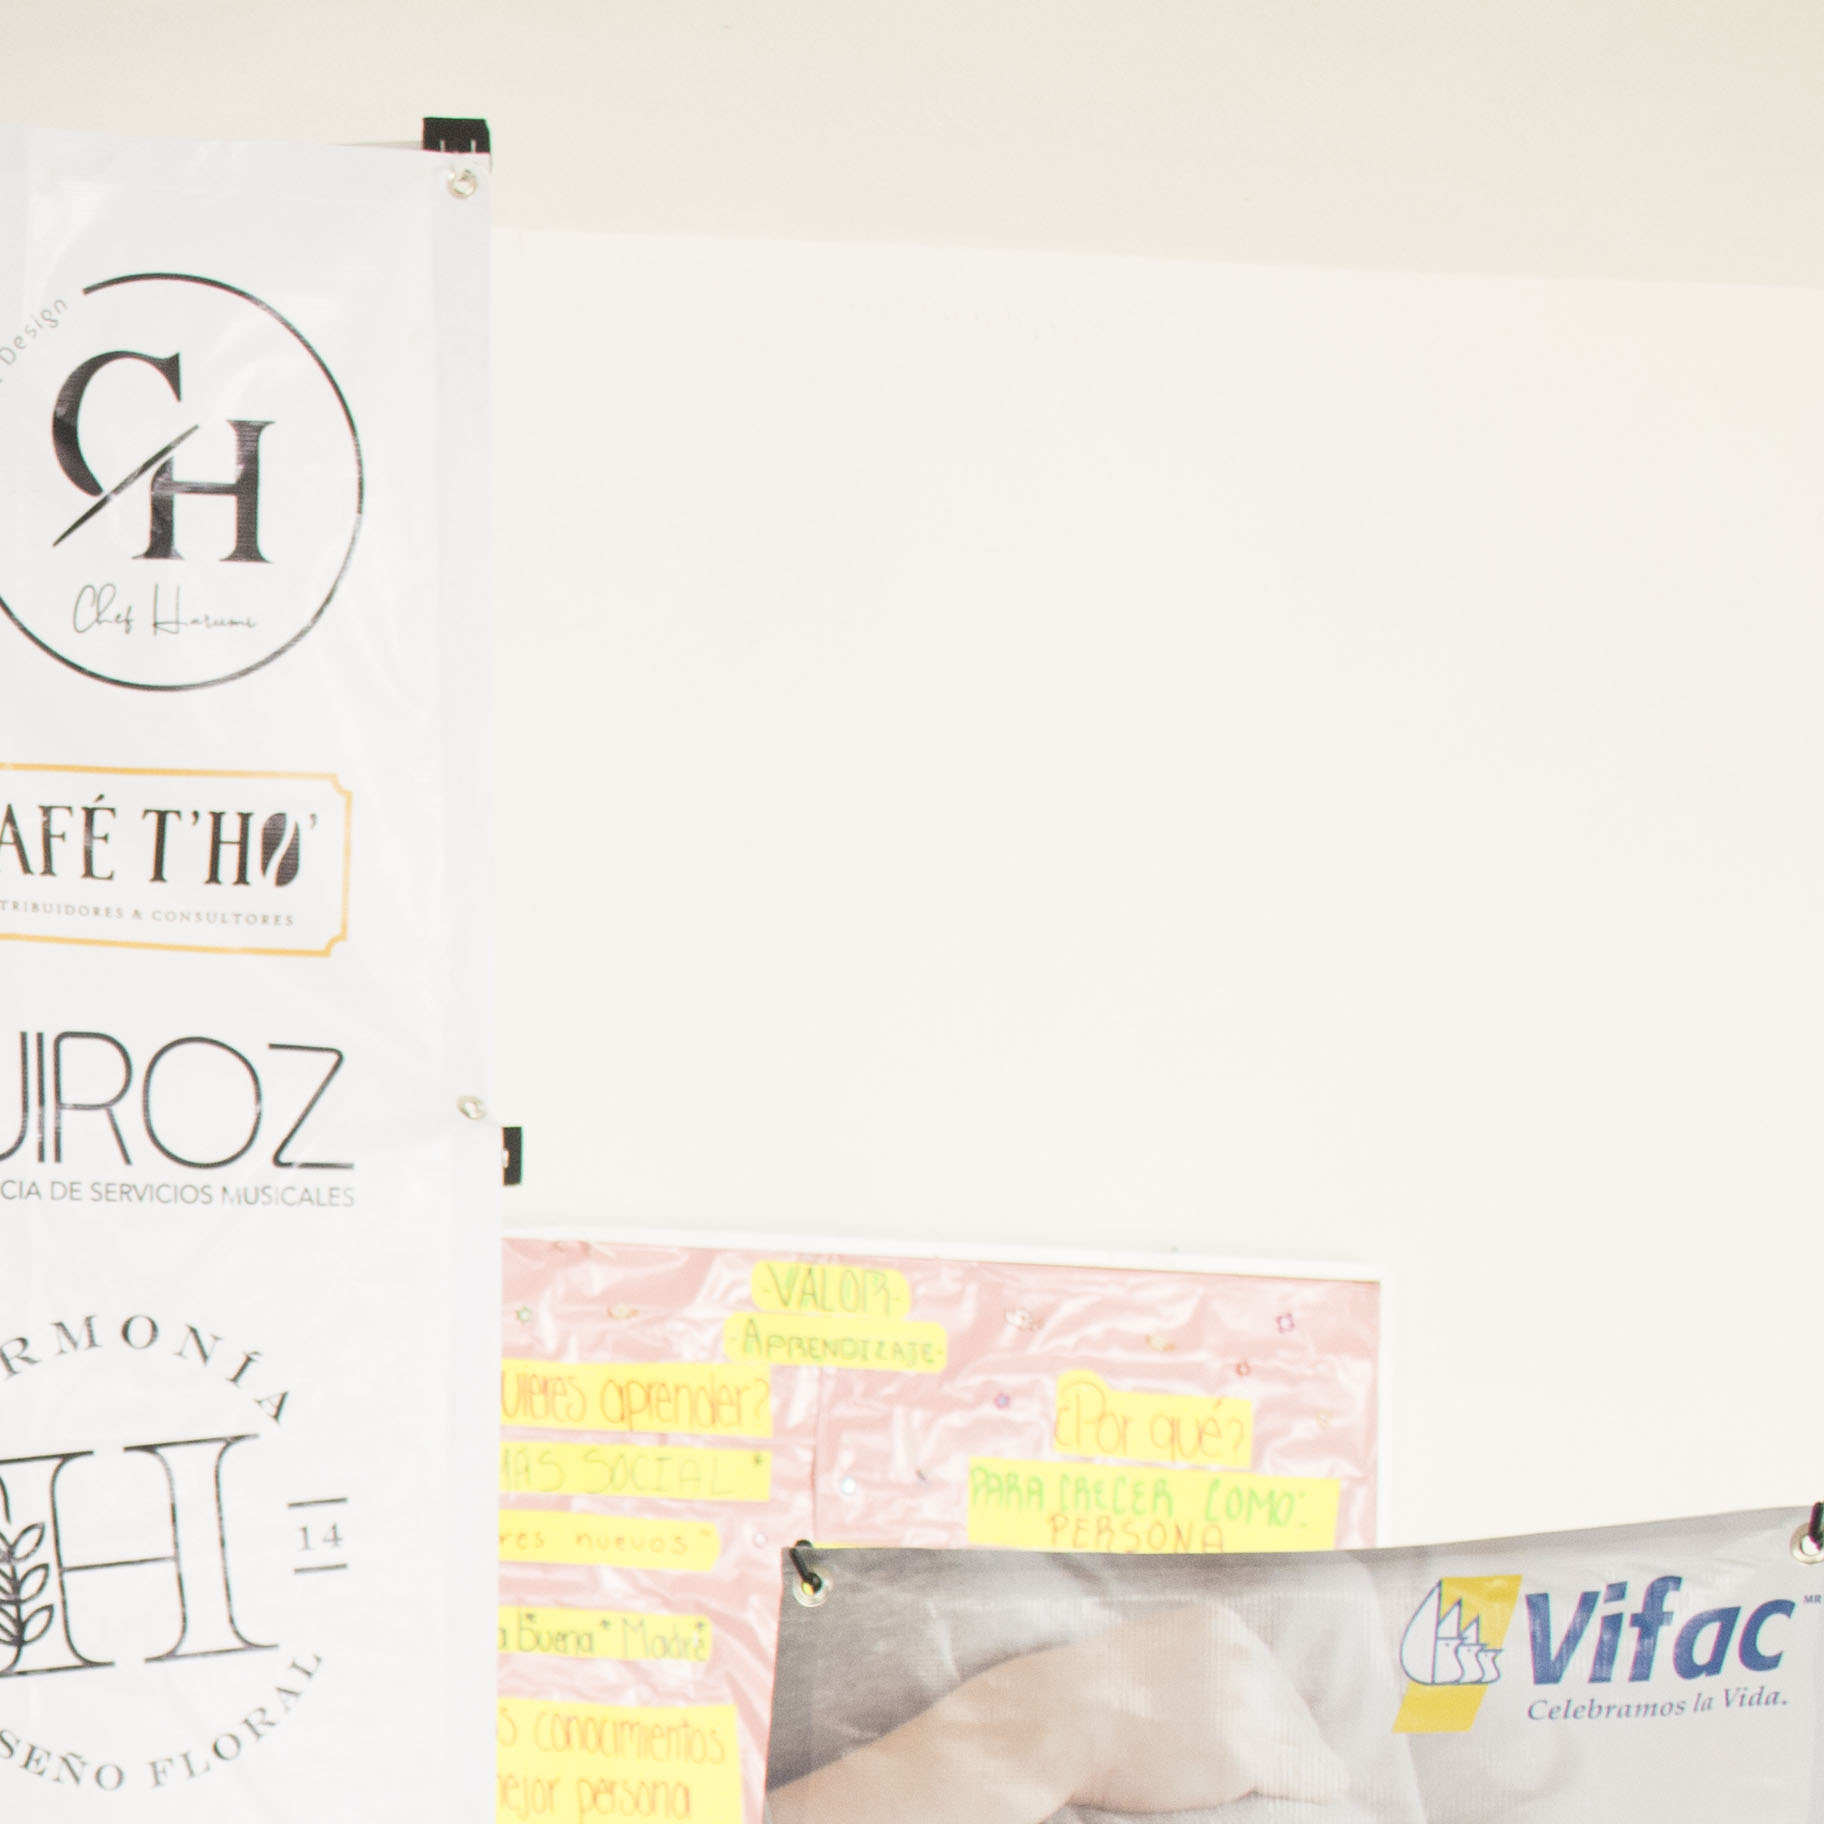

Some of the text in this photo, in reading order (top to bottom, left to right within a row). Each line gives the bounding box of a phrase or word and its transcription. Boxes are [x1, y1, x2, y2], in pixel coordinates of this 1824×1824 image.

[72, 583, 134, 635] Chef
[132, 907, 143, 919] &
[152, 909, 295, 927] CONSULTORES
[49, 1181, 82, 1202] DE
[90, 1182, 214, 1204] SERVICIOS
[221, 1185, 355, 1206] MUSICALES
[296, 1523, 342, 1550] 14
[1525, 1575, 1796, 1685] Vifac
[147, 1650, 323, 1789] FLORAL
[1527, 1687, 1787, 1720] Celebramos la Vida.
